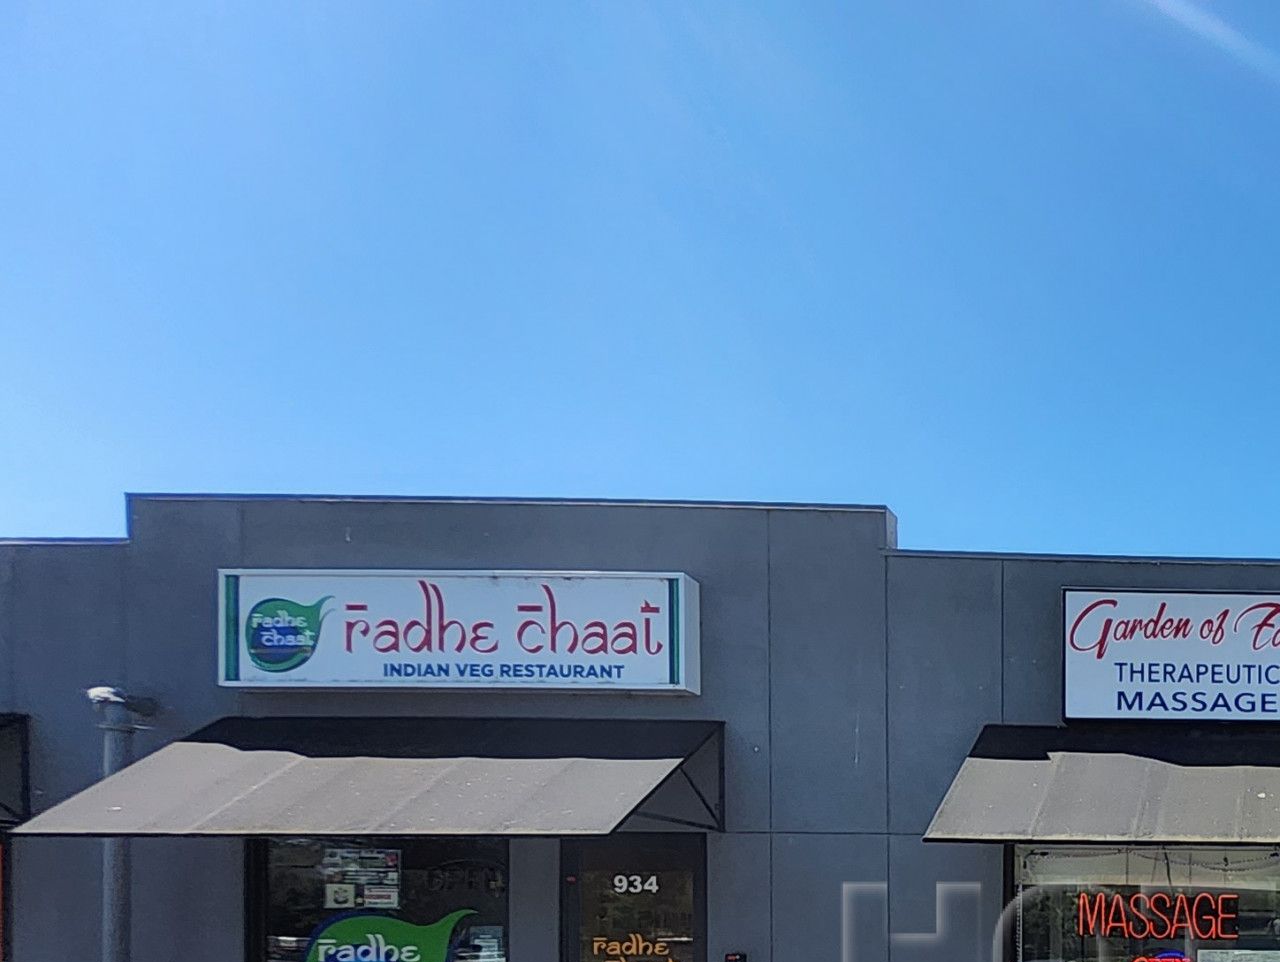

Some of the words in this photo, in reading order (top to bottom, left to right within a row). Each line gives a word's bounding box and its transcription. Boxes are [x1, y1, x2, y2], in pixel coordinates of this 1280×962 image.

[345, 580, 499, 654] radhe
[516, 584, 663, 655] chaat
[1069, 599, 1193, 660] Garden
[1200, 608, 1230, 645] of
[383, 663, 447, 677] INDIAN
[455, 663, 494, 678] VEG
[499, 664, 624, 679] RESTAURANT
[1114, 662, 1280, 685] THERAPEUTIC
[1116, 691, 1278, 713] MASSAGE
[613, 875, 659, 893] 934
[1078, 892, 1240, 940] MASSAGE
[316, 934, 421, 962] radhe
[593, 933, 669, 955] radhe
